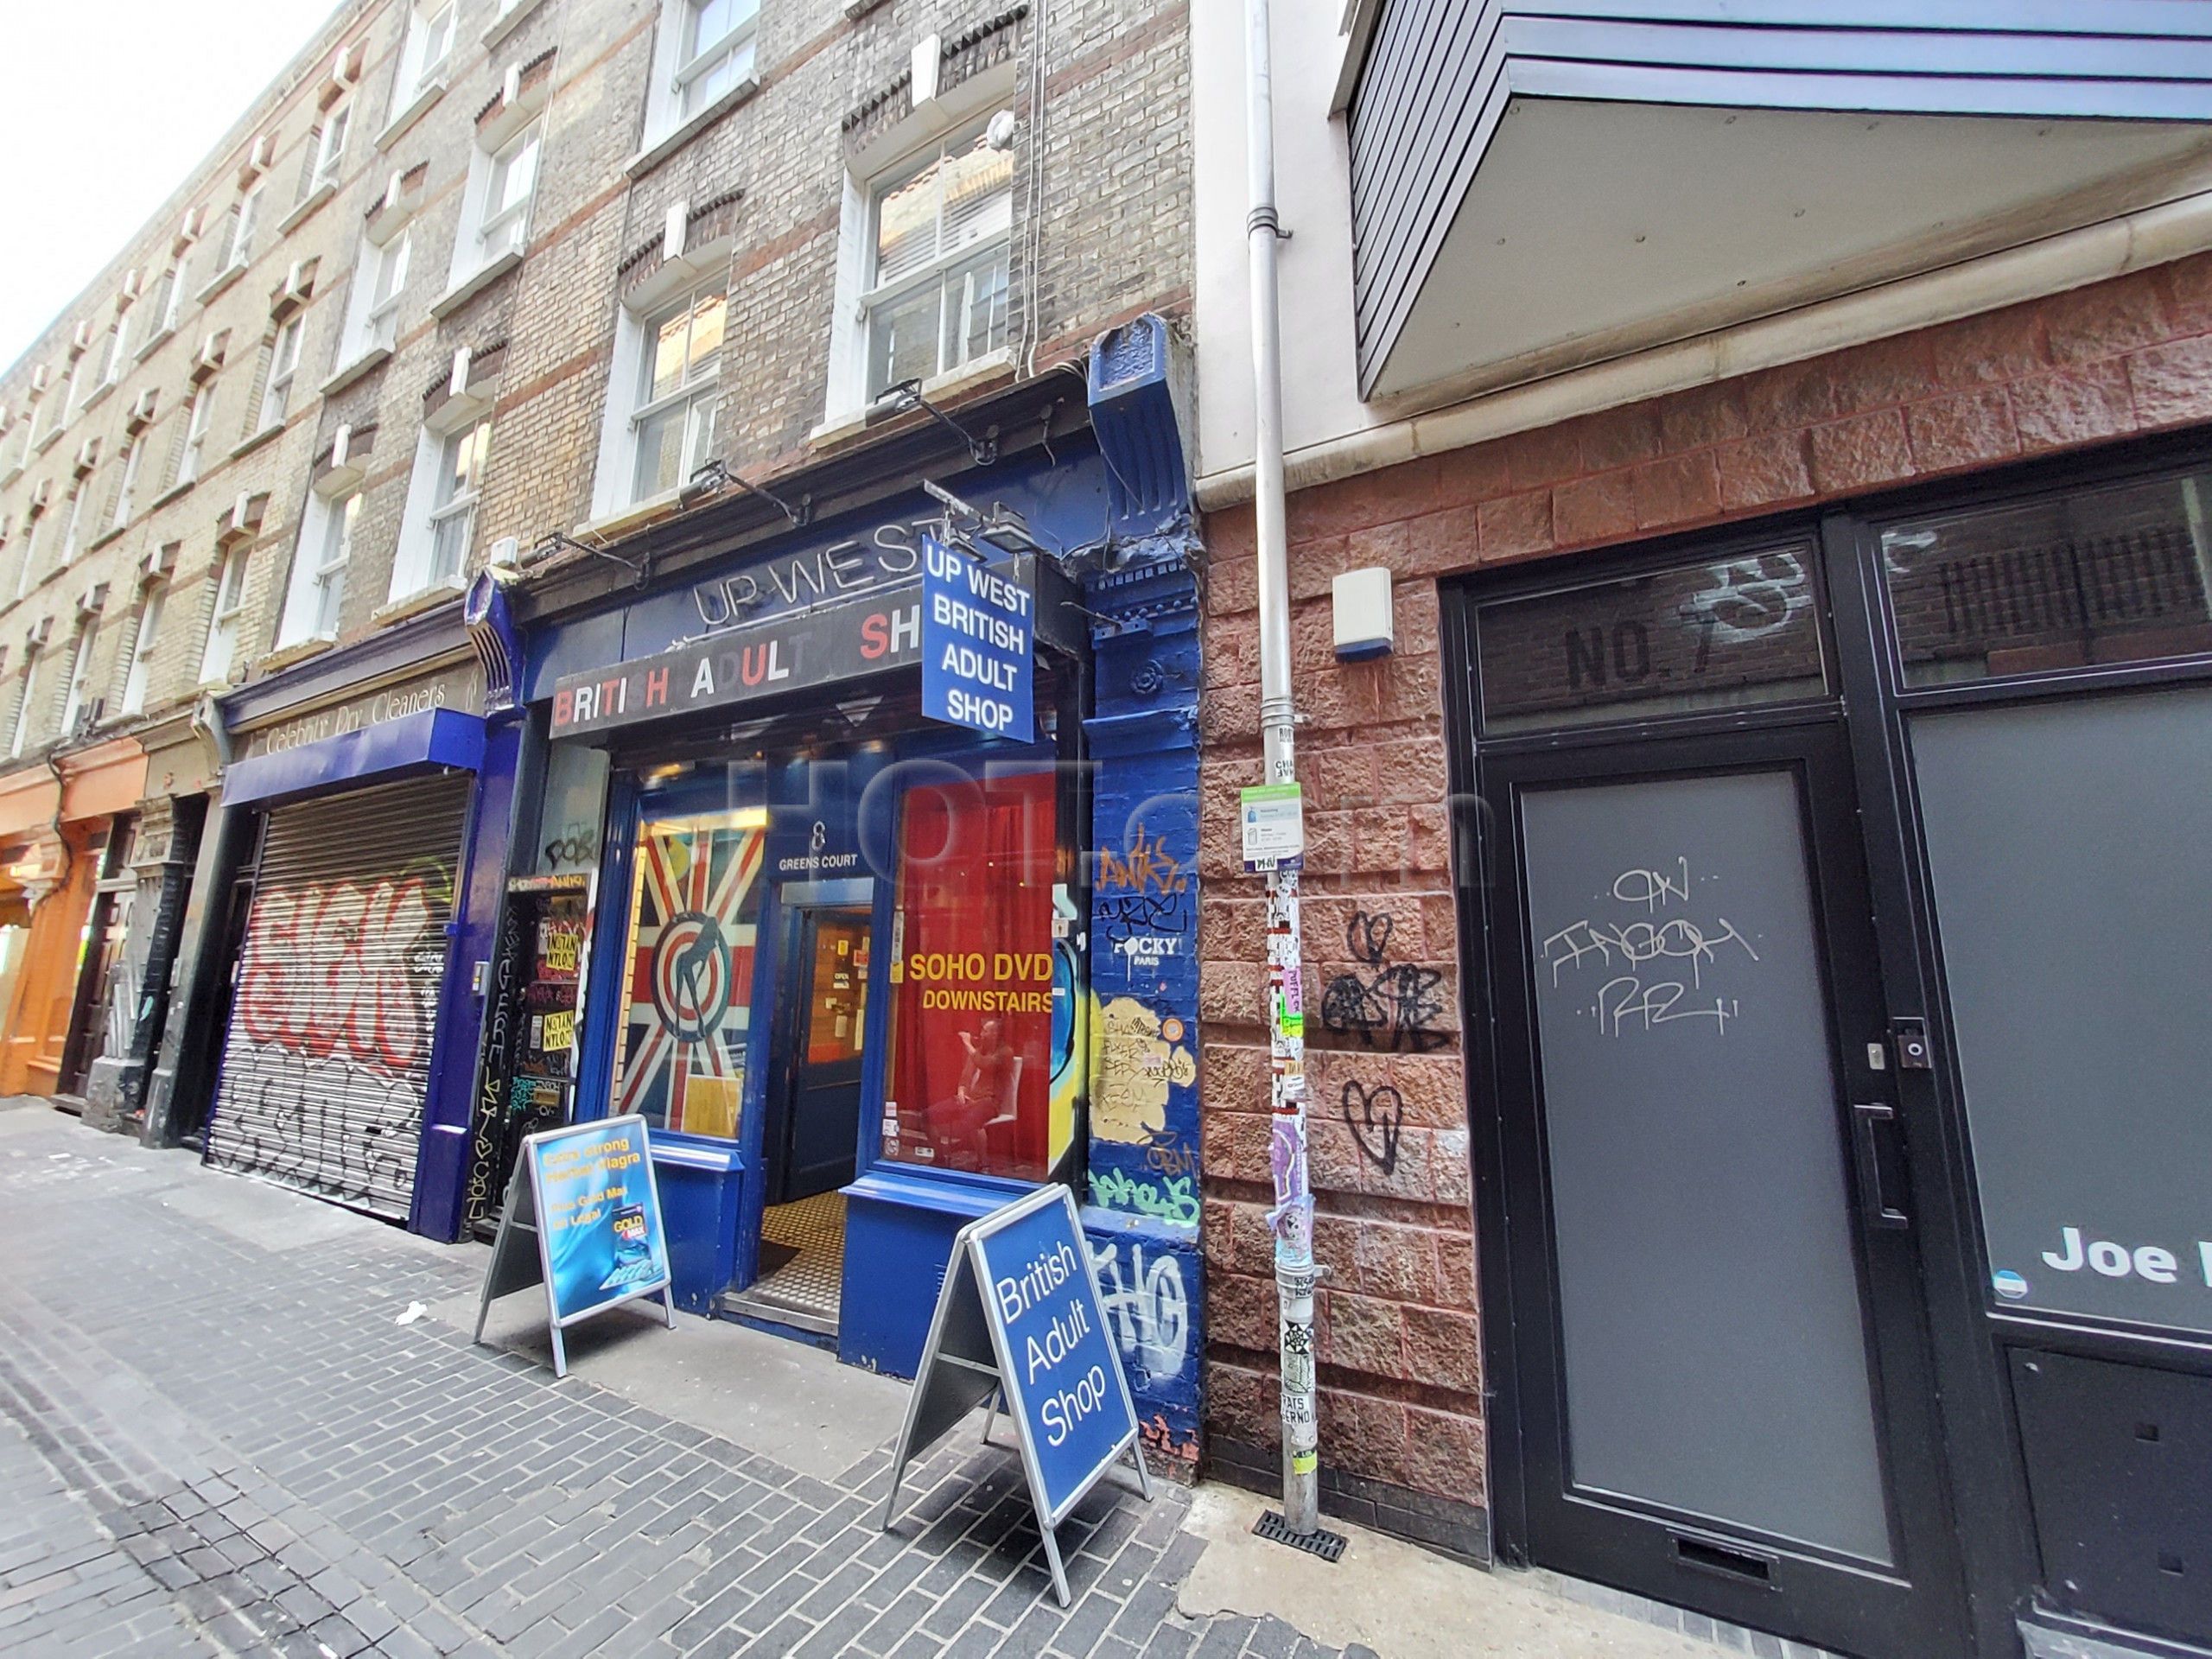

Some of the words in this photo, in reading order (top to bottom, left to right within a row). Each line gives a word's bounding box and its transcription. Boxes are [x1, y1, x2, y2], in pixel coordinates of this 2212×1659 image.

[693, 575, 757, 625] UP
[927, 544, 962, 582] UP
[967, 564, 1030, 617] WEST
[934, 593, 1024, 655] BRITISH
[555, 668, 669, 726] BRITIH
[861, 605, 920, 658] SH
[941, 644, 1017, 692] ADULT
[372, 683, 446, 724] Cleaners
[947, 689, 1014, 732] SHOP
[811, 820, 826, 852] 8
[779, 855, 820, 872] GREENS
[822, 854, 858, 868] COURT
[910, 954, 986, 982] SOHO
[994, 952, 1053, 981] DVD
[1134, 957, 1160, 966] PARIS
[922, 989, 1053, 1014] DOWNSTAIRS
[614, 1215, 644, 1233] GOLD
[2041, 1226, 2178, 1284] Joe
[996, 1241, 1077, 1325] British
[1027, 1299, 1090, 1385] Adult
[1041, 1364, 1106, 1447] Shop
